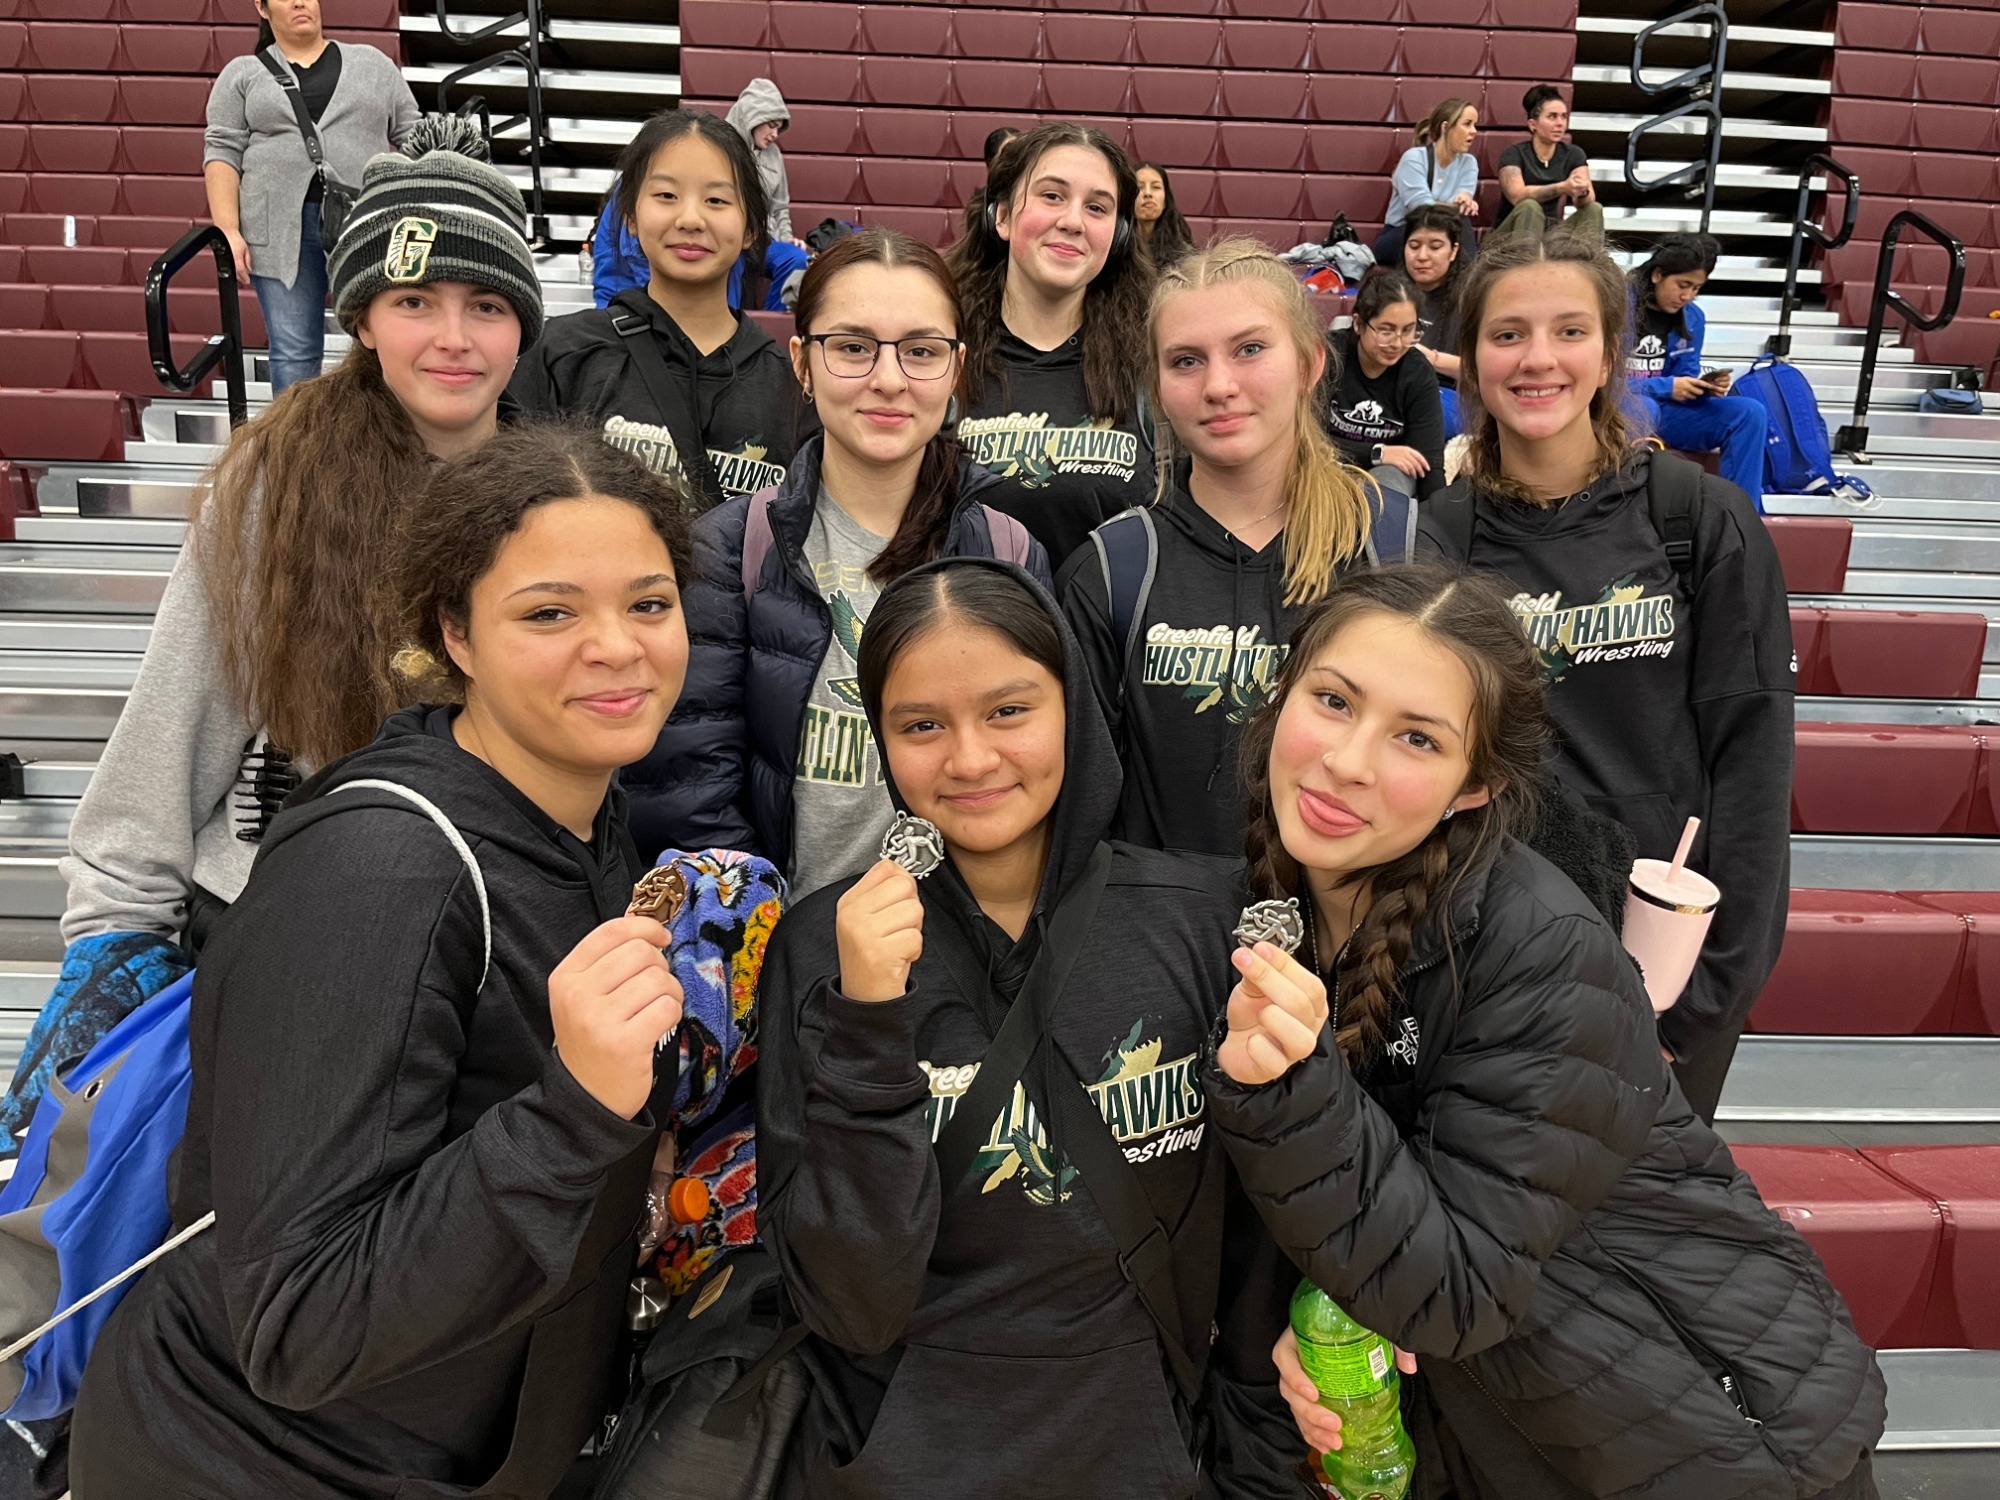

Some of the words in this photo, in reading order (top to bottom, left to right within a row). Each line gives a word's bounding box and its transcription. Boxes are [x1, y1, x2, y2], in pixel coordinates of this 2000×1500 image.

[385, 217, 438, 282] G
[958, 412, 1049, 436] Greenfield
[1056, 428, 1137, 466] HAWKS
[1057, 460, 1135, 483] Wrestling
[1146, 622, 1260, 647] Greenfield
[1570, 594, 1675, 648] HAWKS
[1575, 640, 1674, 664] Wrestling
[1120, 1122, 1206, 1164] estling
